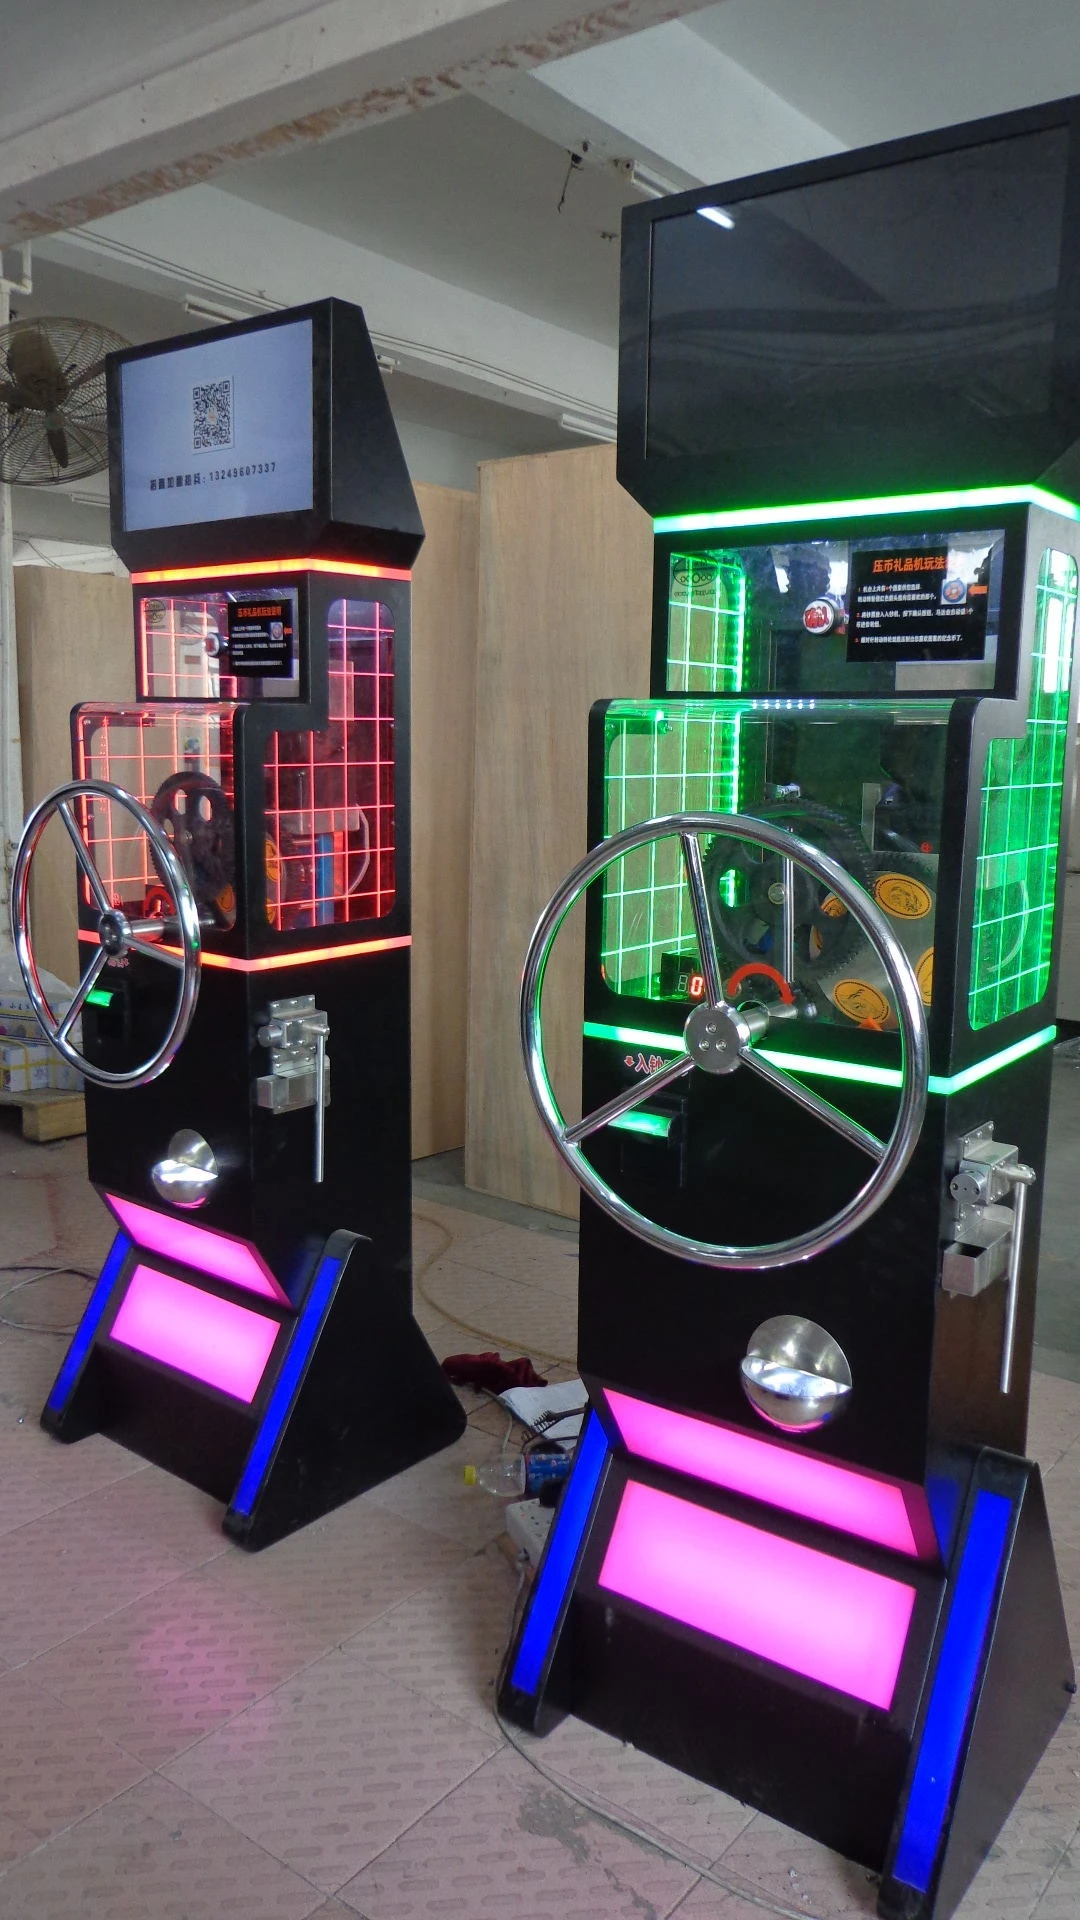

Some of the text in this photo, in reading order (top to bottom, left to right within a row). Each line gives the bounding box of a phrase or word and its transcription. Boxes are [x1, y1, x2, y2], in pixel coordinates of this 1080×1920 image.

[872, 556, 949, 574] 压币礼品机玩法
[691, 976, 704, 996] 0
[635, 1053, 672, 1075] 入钞
